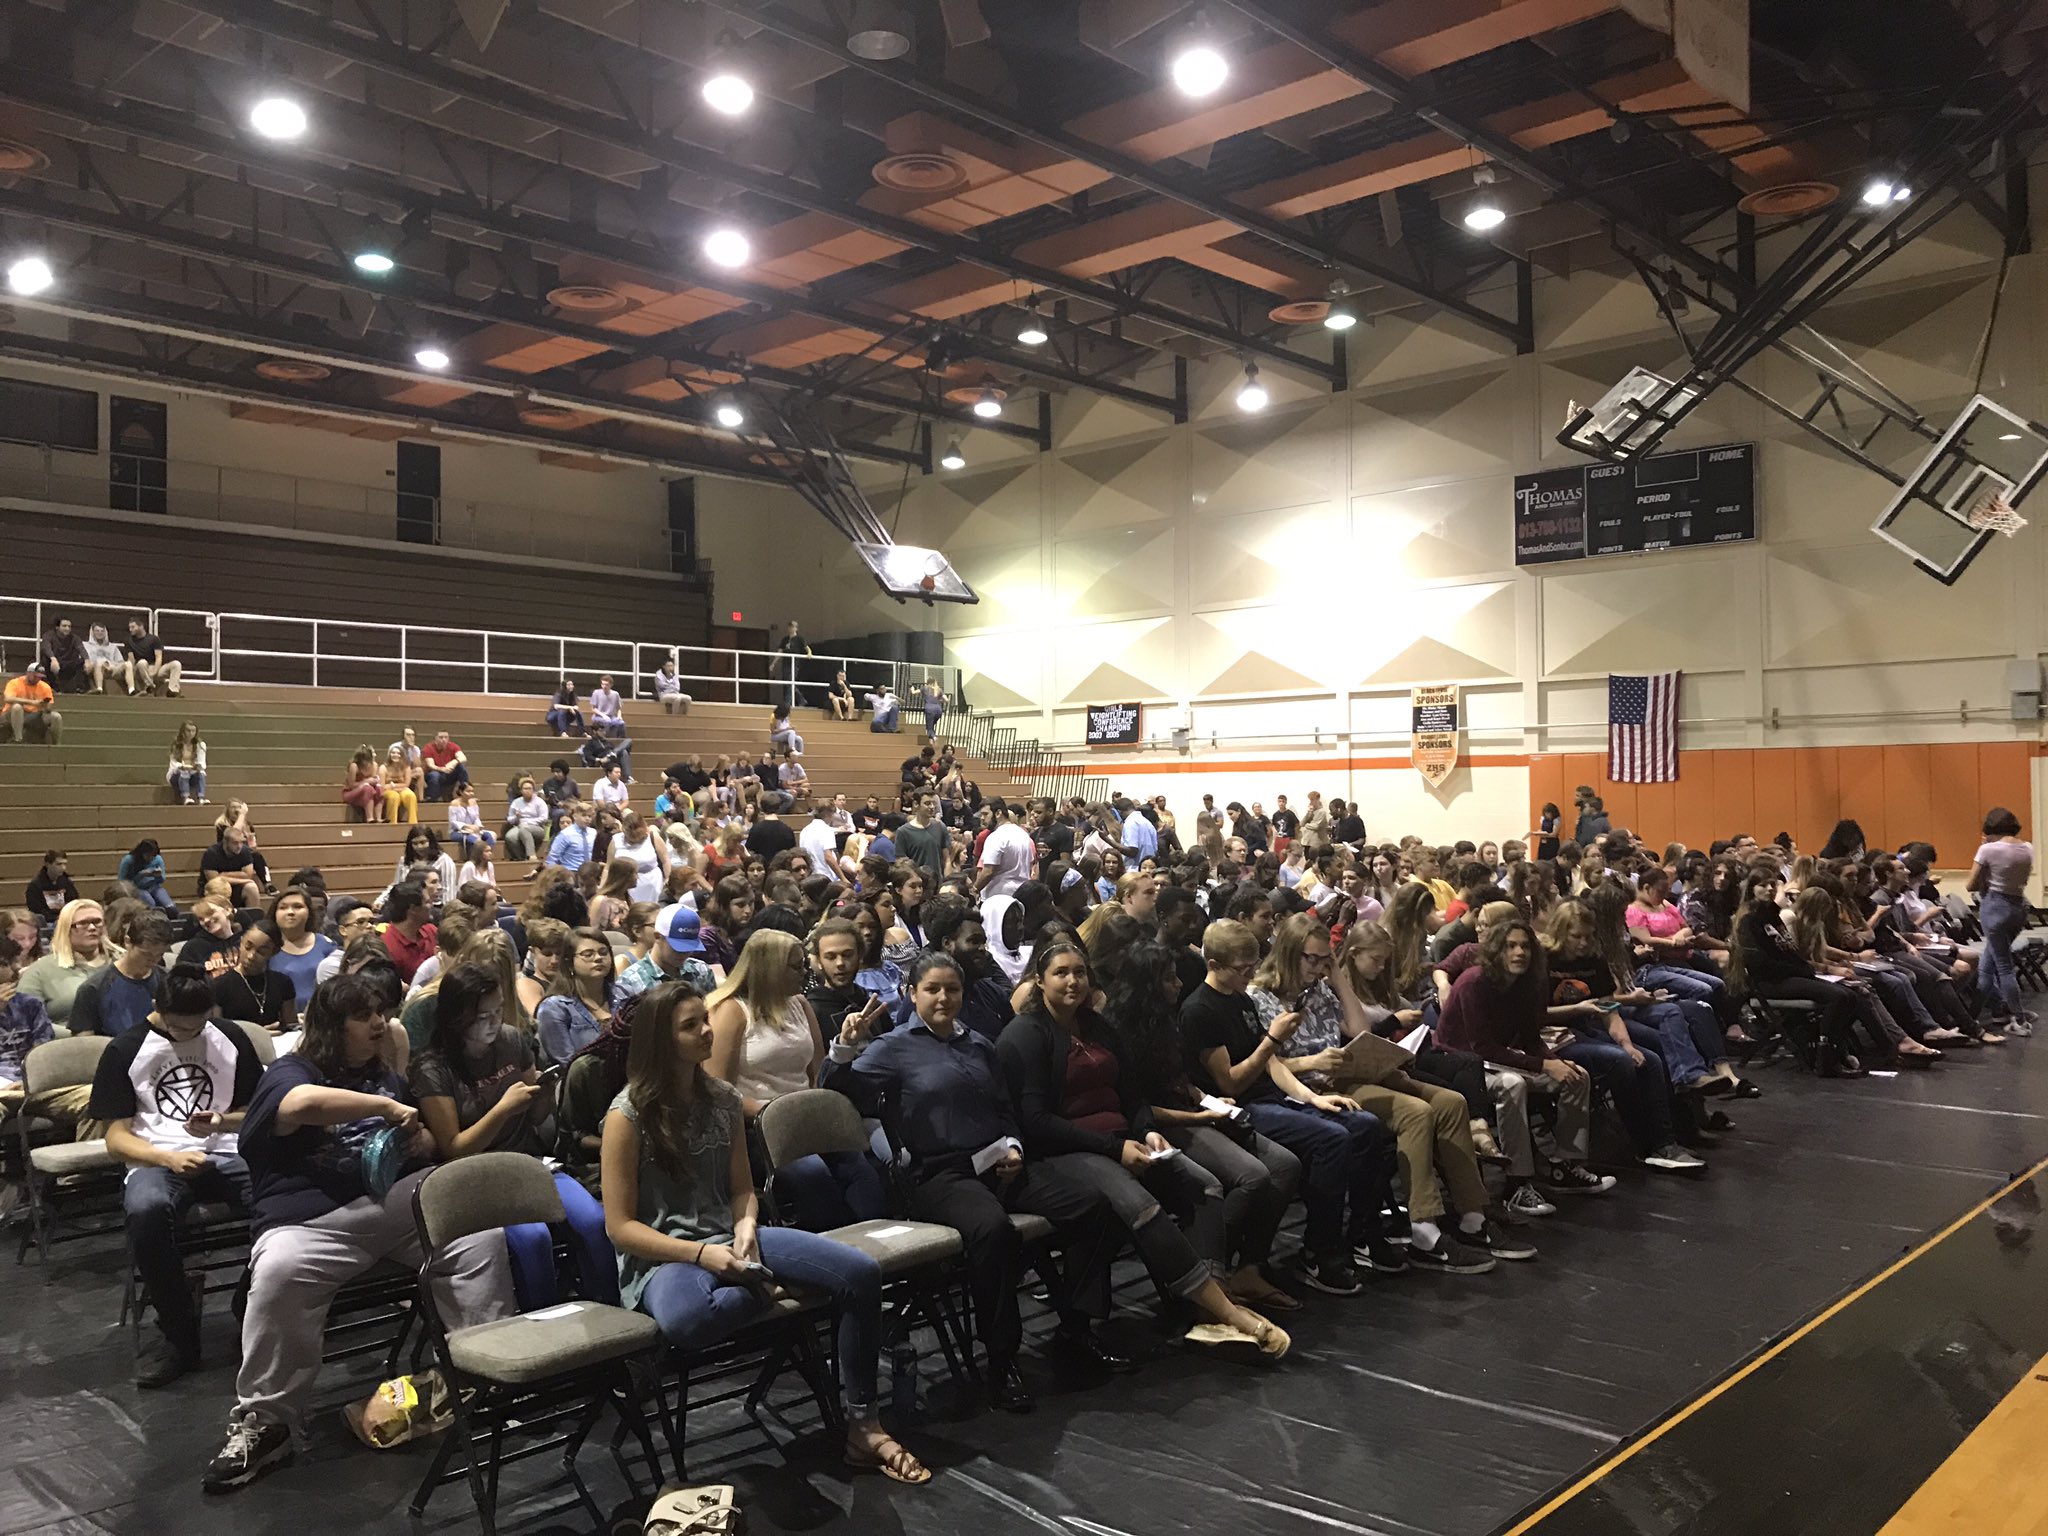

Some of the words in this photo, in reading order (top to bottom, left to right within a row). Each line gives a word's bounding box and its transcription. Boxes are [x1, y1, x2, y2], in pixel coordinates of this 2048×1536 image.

[1708, 448, 1745, 462] HOME
[1591, 465, 1625, 479] GUEST
[1636, 493, 1671, 505] PERIOD
[1715, 505, 1740, 513] FOULS
[1643, 511, 1693, 522] PLAYER-FOUL
[1599, 519, 1622, 527] FOULS
[1714, 532, 1742, 541] POINTS
[1598, 544, 1624, 553] POINTS
[1644, 540, 1671, 549] MATCH
[1416, 694, 1454, 704] SPONSORS
[1090, 710, 1136, 719] WEIGHTLIFTING
[1093, 717, 1133, 726] CONFERENCE
[1096, 724, 1131, 732] CHAMPIONS
[1418, 740, 1452, 749] SPONSORS
[1426, 764, 1445, 772] ZHS
[178, 1055, 199, 1063] YOU
